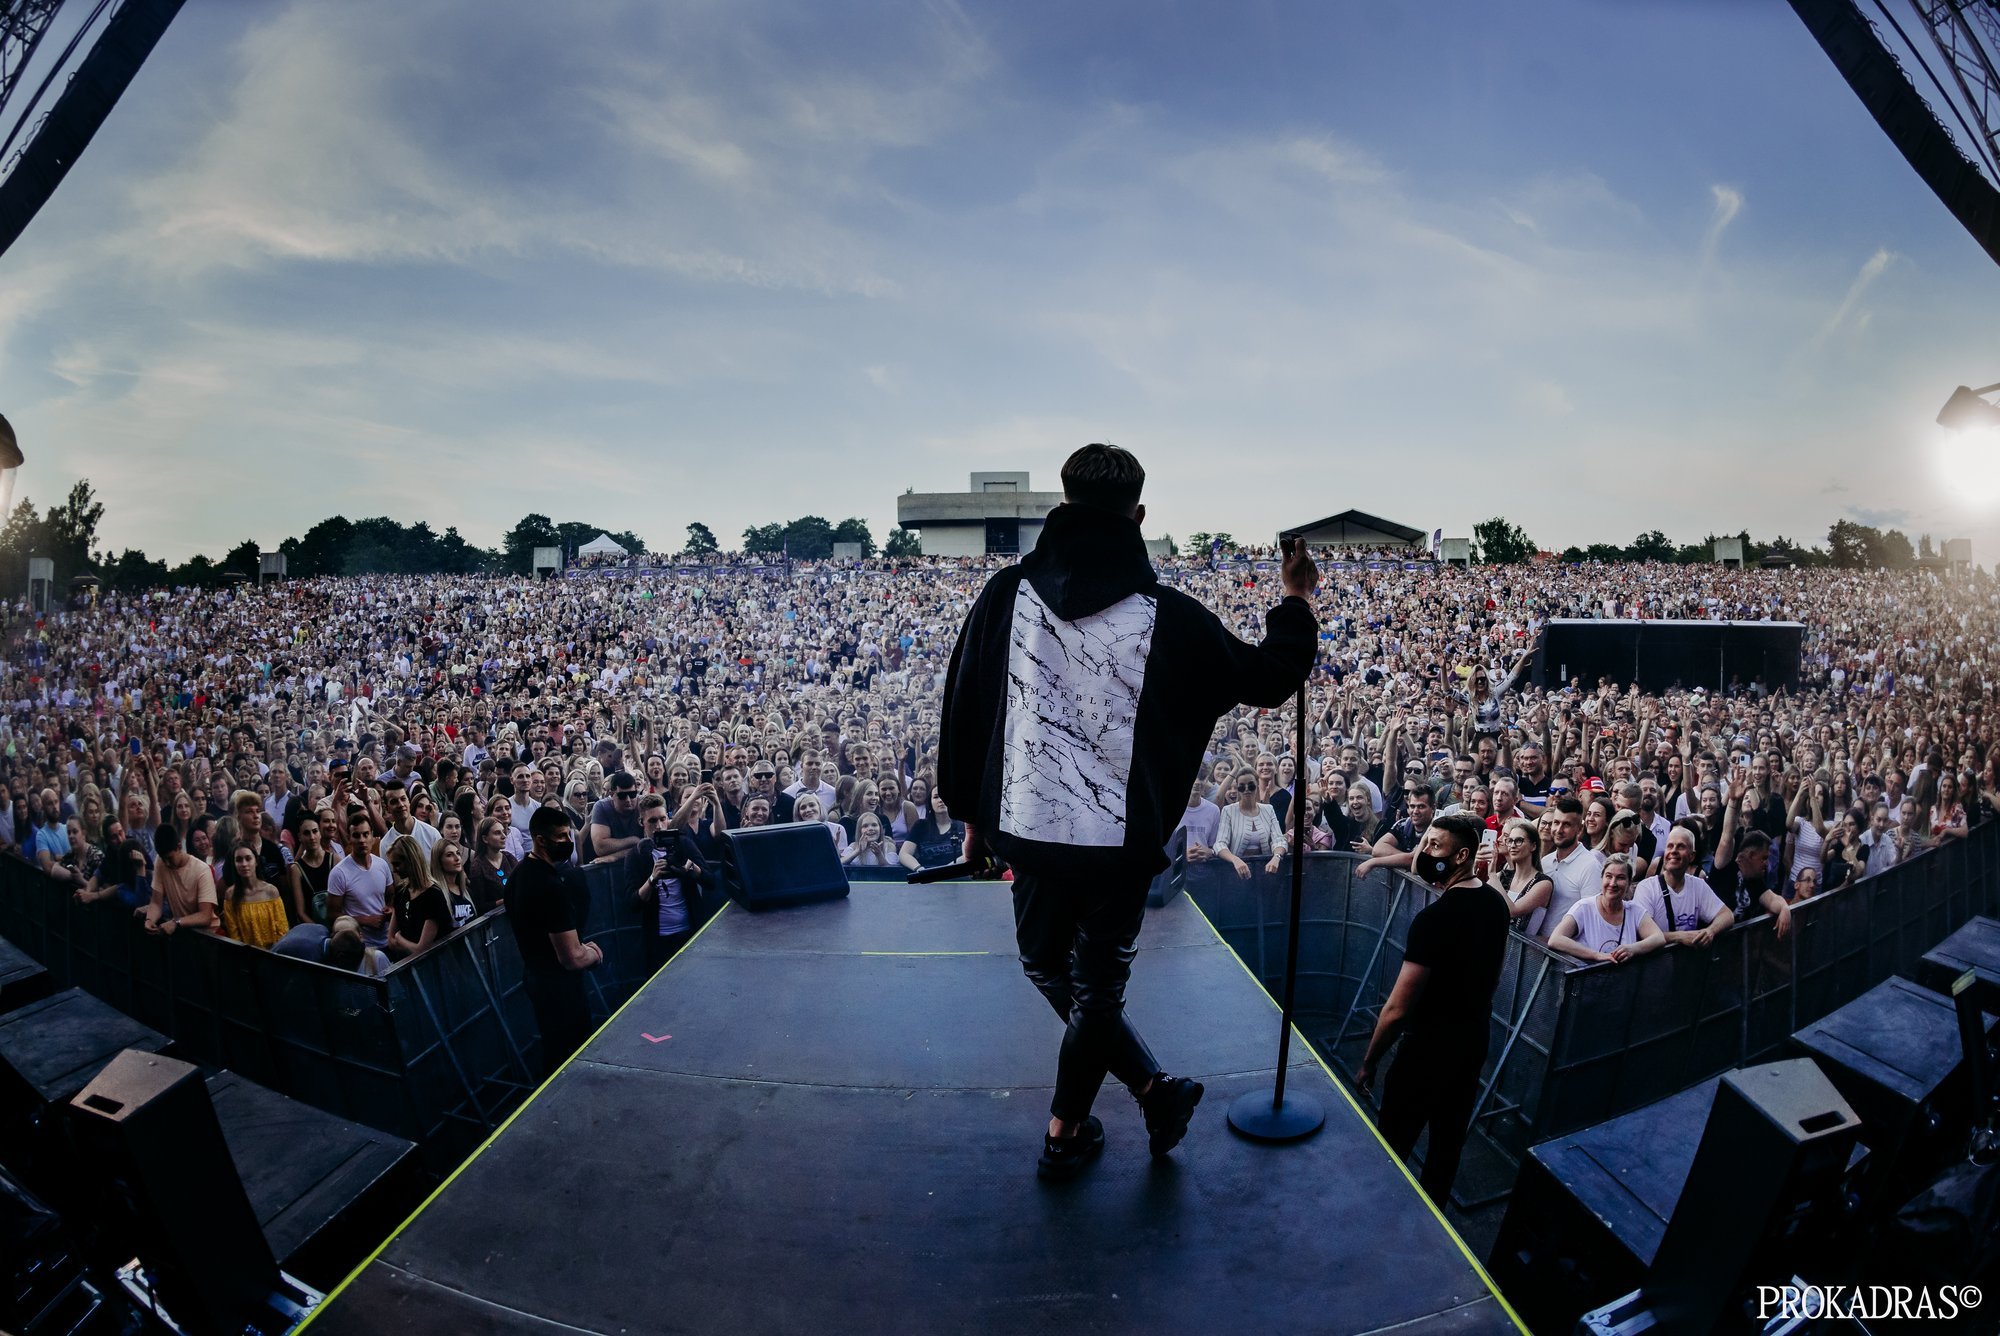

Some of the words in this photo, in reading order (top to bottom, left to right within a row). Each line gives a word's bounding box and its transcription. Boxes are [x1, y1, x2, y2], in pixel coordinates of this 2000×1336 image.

[1030, 687, 1112, 707] MARBLE
[1010, 699, 1132, 724] UNIVERSUM
[454, 904, 472, 918] NIKE
